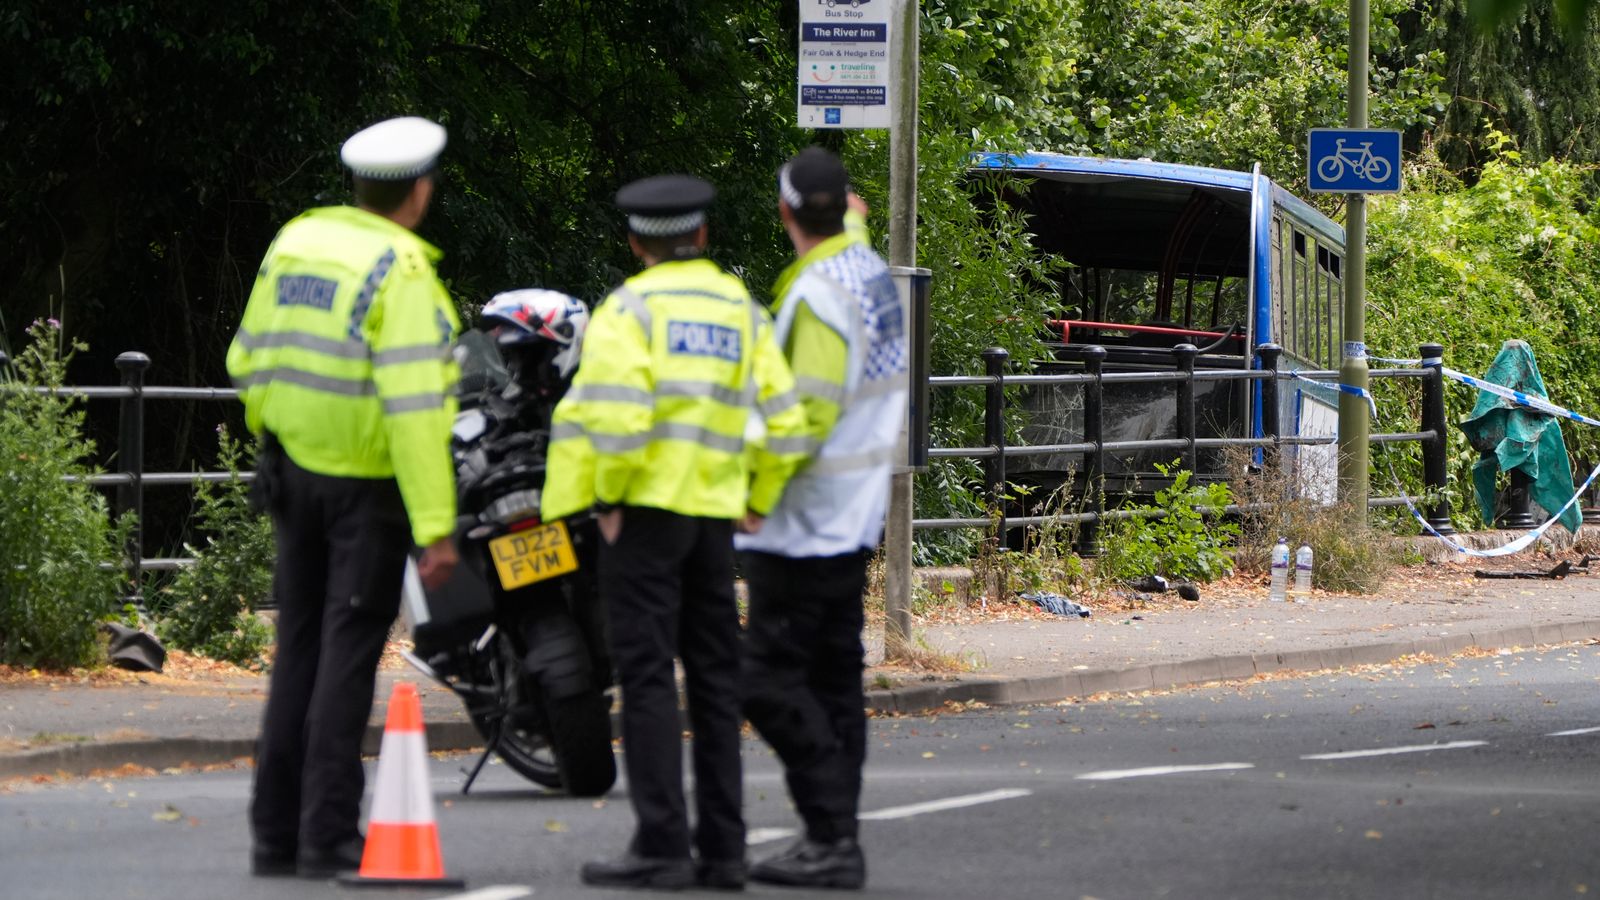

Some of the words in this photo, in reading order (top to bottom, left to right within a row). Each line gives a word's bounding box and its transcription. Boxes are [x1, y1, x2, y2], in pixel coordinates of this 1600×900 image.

[825, 9, 841, 17] Bus
[844, 9, 863, 19] Stop
[813, 27, 831, 37] The
[833, 27, 859, 37] River
[860, 28, 875, 37] Inn
[803, 49, 817, 57] Fair
[819, 49, 834, 57] Oak
[844, 50, 868, 58] Hedge
[278, 276, 336, 309] POLICE
[669, 322, 740, 362] POLICE
[495, 524, 563, 562] LD22
[510, 550, 562, 581] FVM
